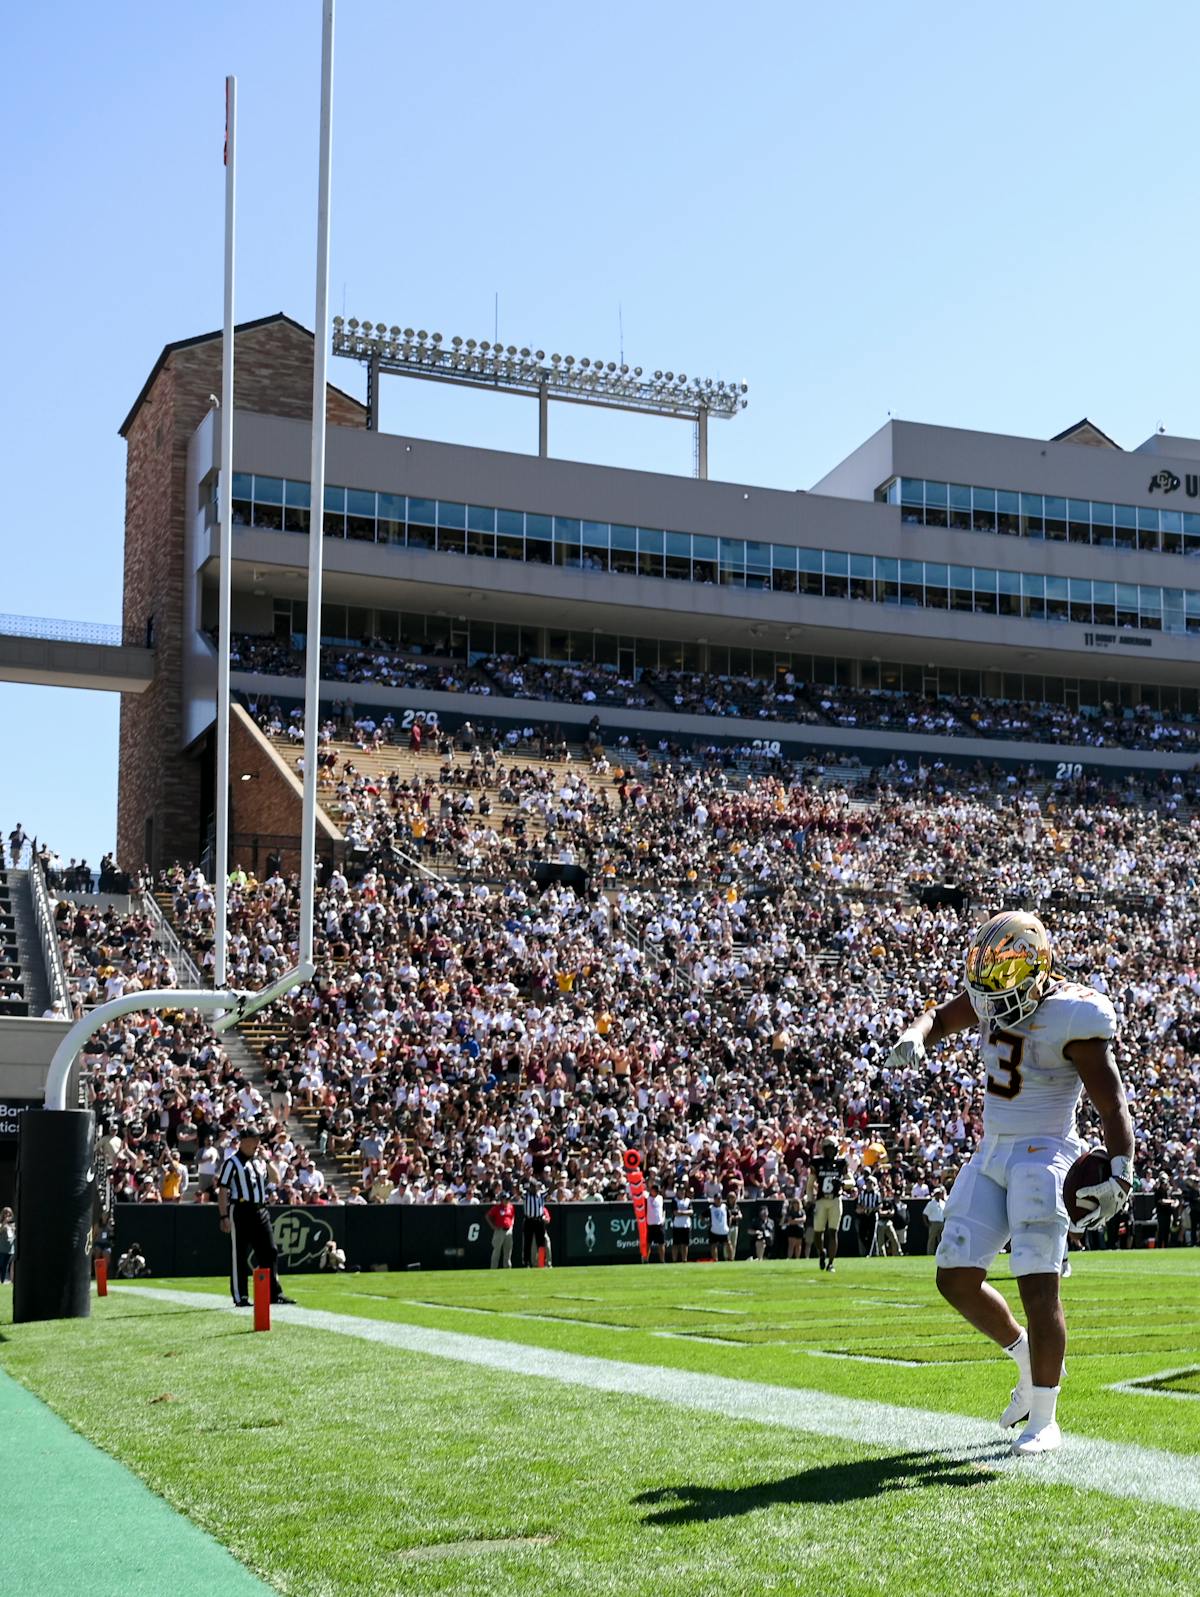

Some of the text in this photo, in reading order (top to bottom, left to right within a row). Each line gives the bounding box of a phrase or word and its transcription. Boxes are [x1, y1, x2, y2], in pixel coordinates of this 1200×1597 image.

[1084, 632, 1094, 646] 11
[986, 1031, 1025, 1101] 3
[822, 1176, 834, 1193] 6
[468, 1223, 480, 1241] G
